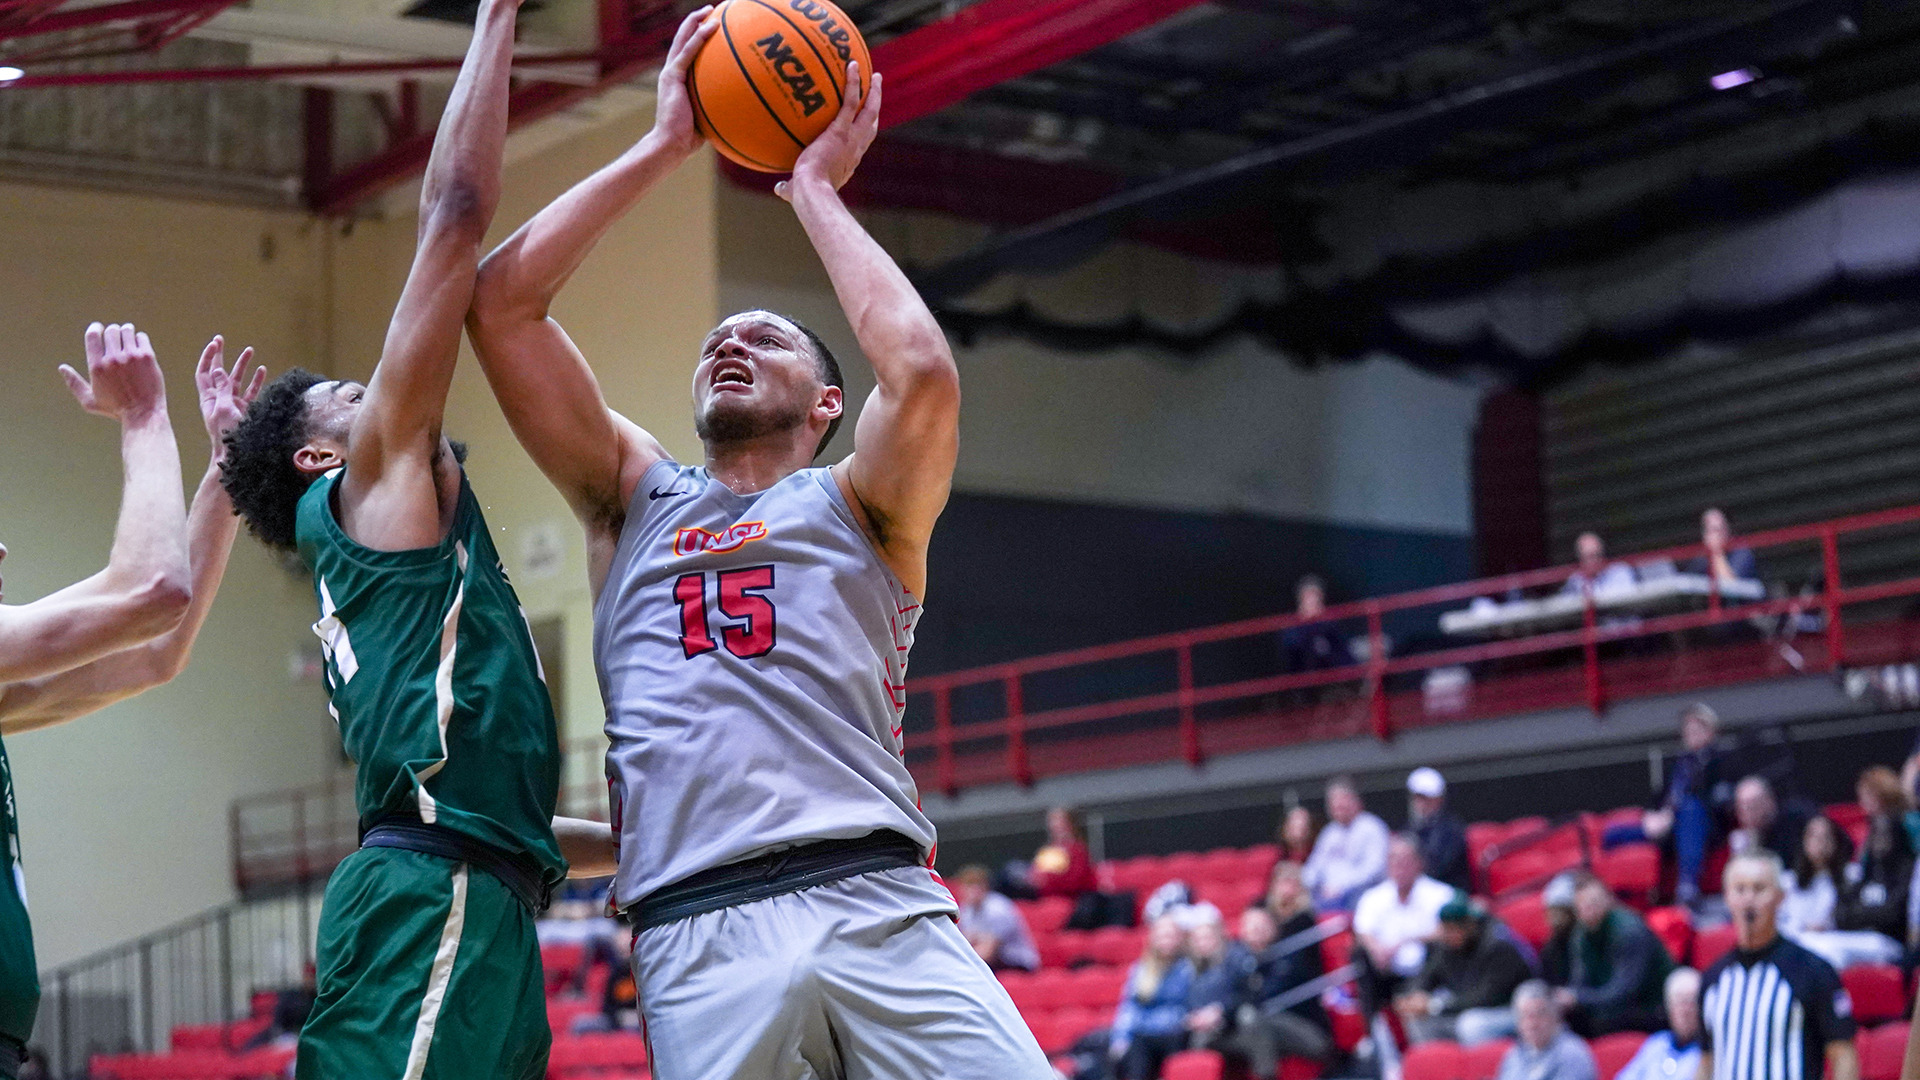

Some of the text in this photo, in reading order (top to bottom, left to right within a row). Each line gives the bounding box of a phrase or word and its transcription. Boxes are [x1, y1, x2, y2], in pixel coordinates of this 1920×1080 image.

[756, 32, 826, 118] NCAA
[673, 521, 769, 557] UMSL
[672, 564, 776, 660] 15
